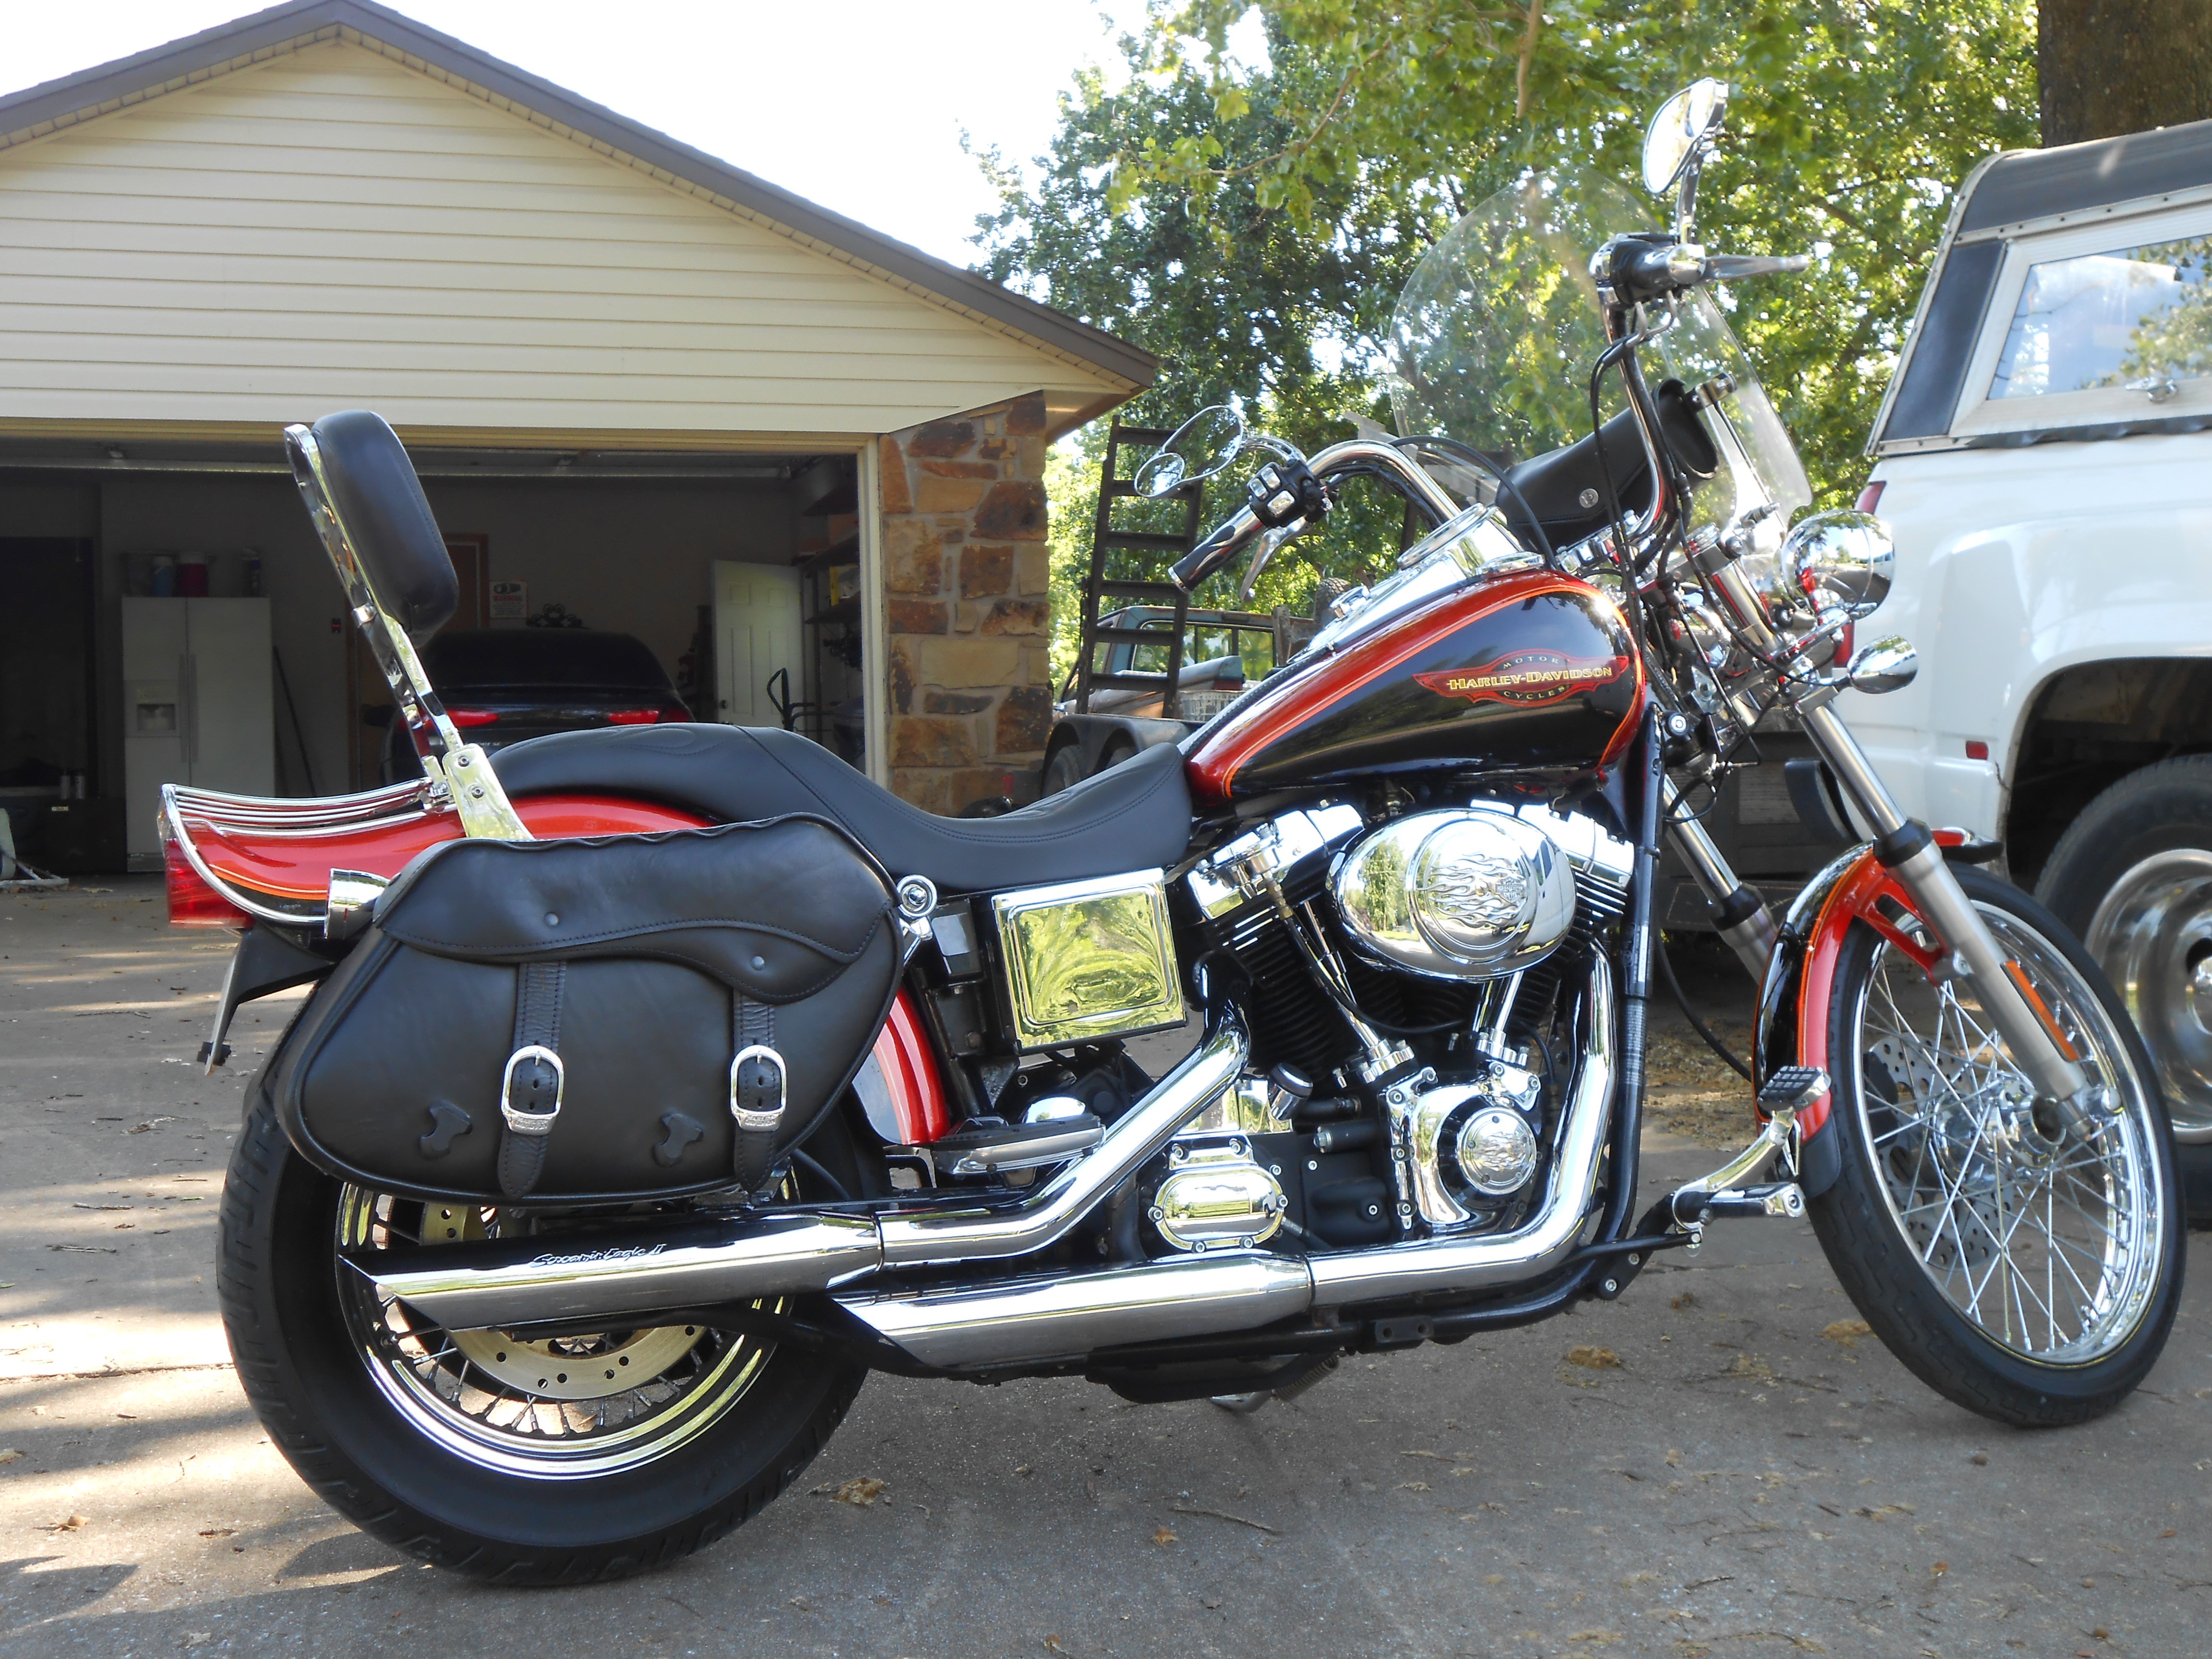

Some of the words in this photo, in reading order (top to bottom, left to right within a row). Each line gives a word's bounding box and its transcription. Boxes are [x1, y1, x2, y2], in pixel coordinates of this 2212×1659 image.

[1503, 656, 1559, 669] MOTOR
[1447, 667, 1612, 690] HARLEY-DAVIDSON
[1503, 685, 1565, 700] CYCLES
[603, 1247, 646, 1262] Eagle
